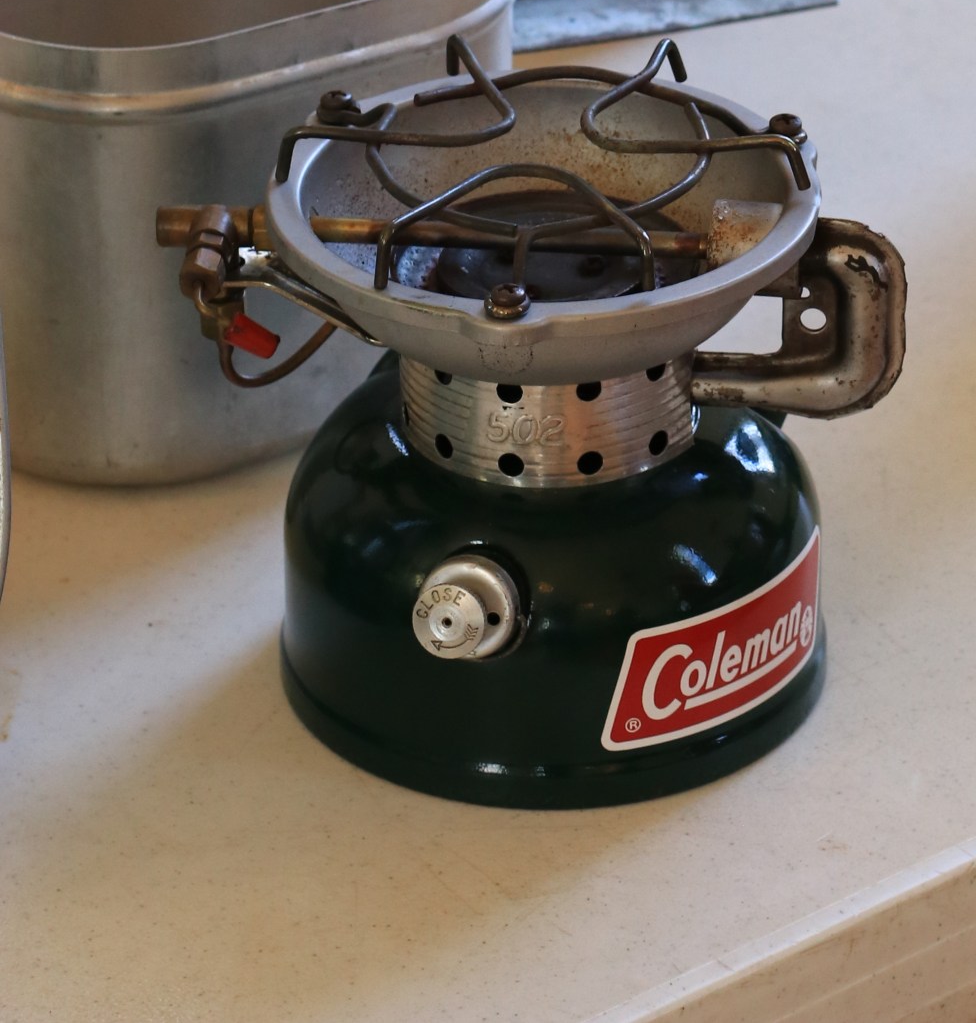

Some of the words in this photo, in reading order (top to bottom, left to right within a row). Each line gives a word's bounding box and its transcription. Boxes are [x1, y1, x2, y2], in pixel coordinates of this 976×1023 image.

[486, 411, 568, 447] 502
[416, 587, 466, 619] CLOSE
[641, 601, 802, 721] Coleman
